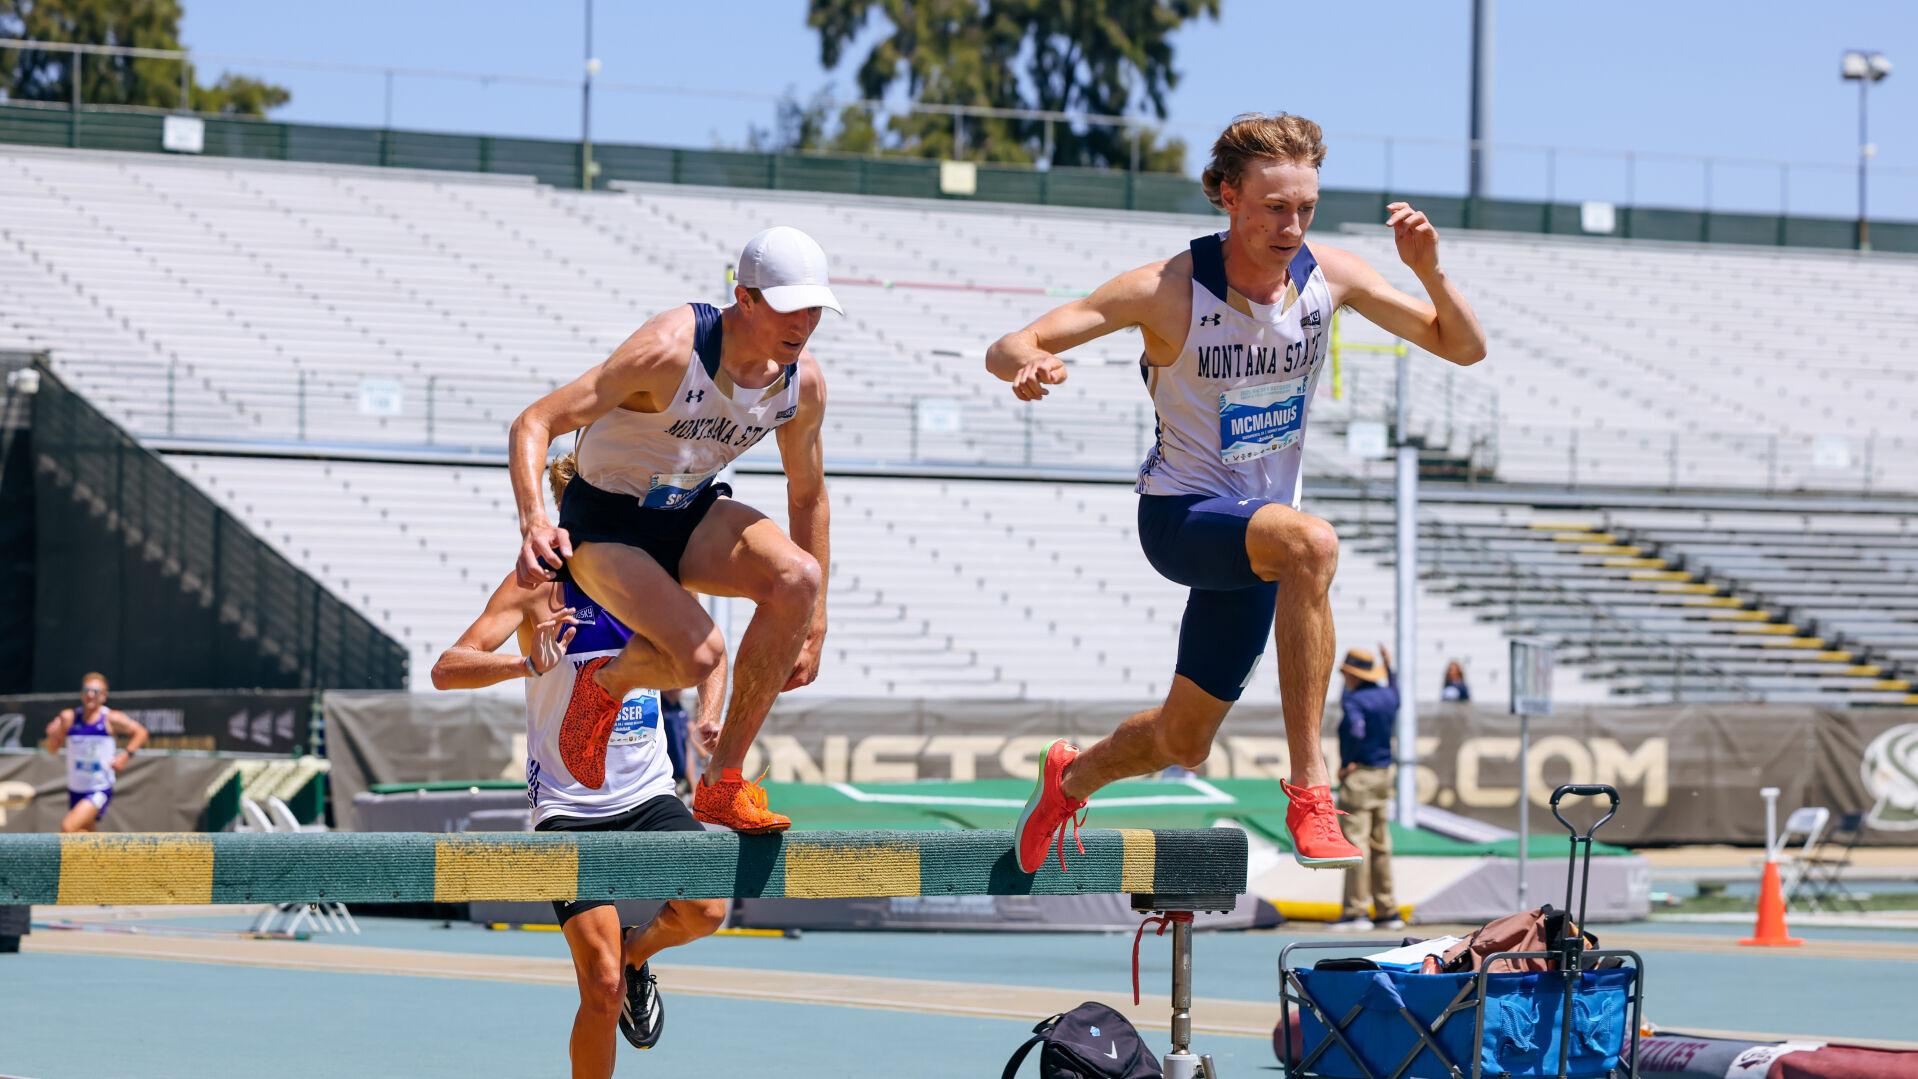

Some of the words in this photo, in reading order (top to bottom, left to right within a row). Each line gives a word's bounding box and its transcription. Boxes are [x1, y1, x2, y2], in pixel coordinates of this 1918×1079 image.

[1198, 343, 1276, 379] MONTANA
[664, 417, 737, 444] MONTANA
[1231, 405, 1297, 435] MCMANUS
